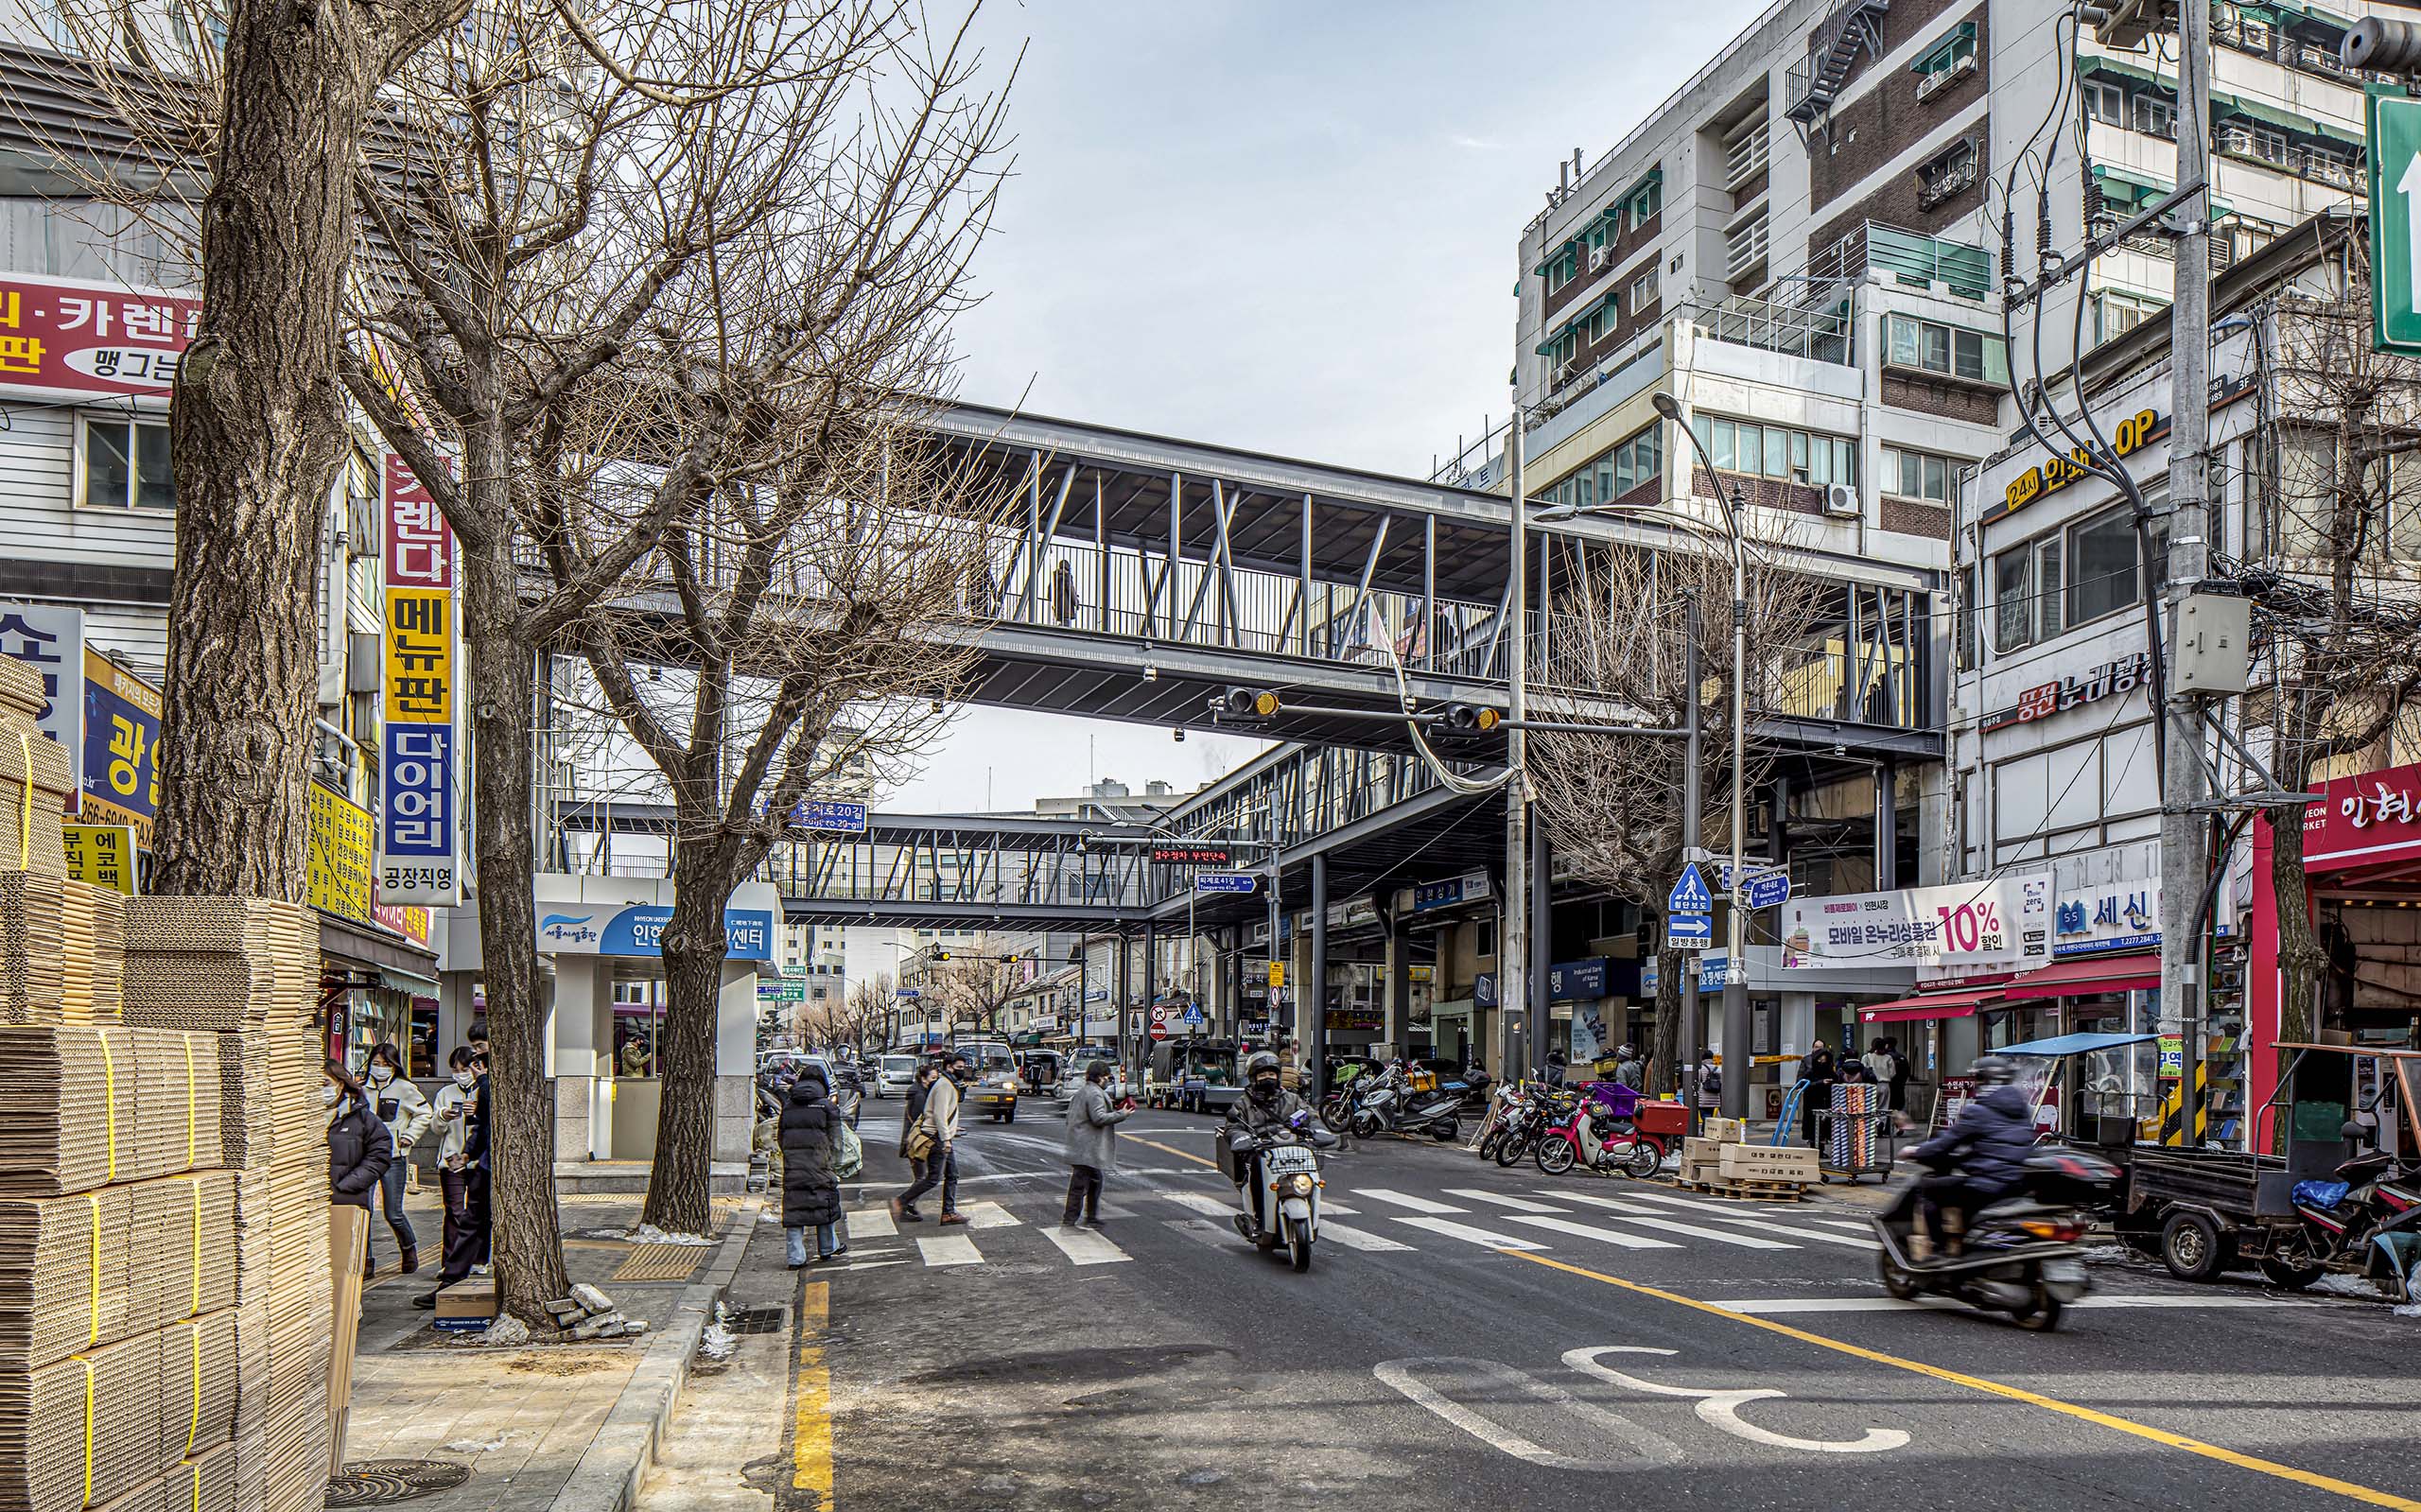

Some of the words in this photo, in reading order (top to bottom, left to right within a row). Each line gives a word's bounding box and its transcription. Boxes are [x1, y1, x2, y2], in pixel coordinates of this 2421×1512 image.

[2238, 376, 2250, 391] 3F
[2010, 477, 2036, 505] 24시
[2116, 408, 2155, 455] OP
[394, 598, 448, 714] 메뉴판
[393, 733, 448, 848] 다이어리
[2341, 781, 2421, 829] 인현
[133, 819, 152, 846] FAX
[385, 867, 452, 890] 공장직영
[1864, 899, 1889, 912] 인현시장
[2064, 912, 2079, 923] SS
[2093, 891, 2148, 930] 세신
[546, 925, 598, 943] 서울시설공단
[1828, 925, 1863, 946] 모바일
[1865, 921, 1938, 945] 온누리상품권
[1937, 901, 1999, 952] 10%
[1671, 937, 1708, 947] 일방통행
[1981, 934, 2003, 951] 할인
